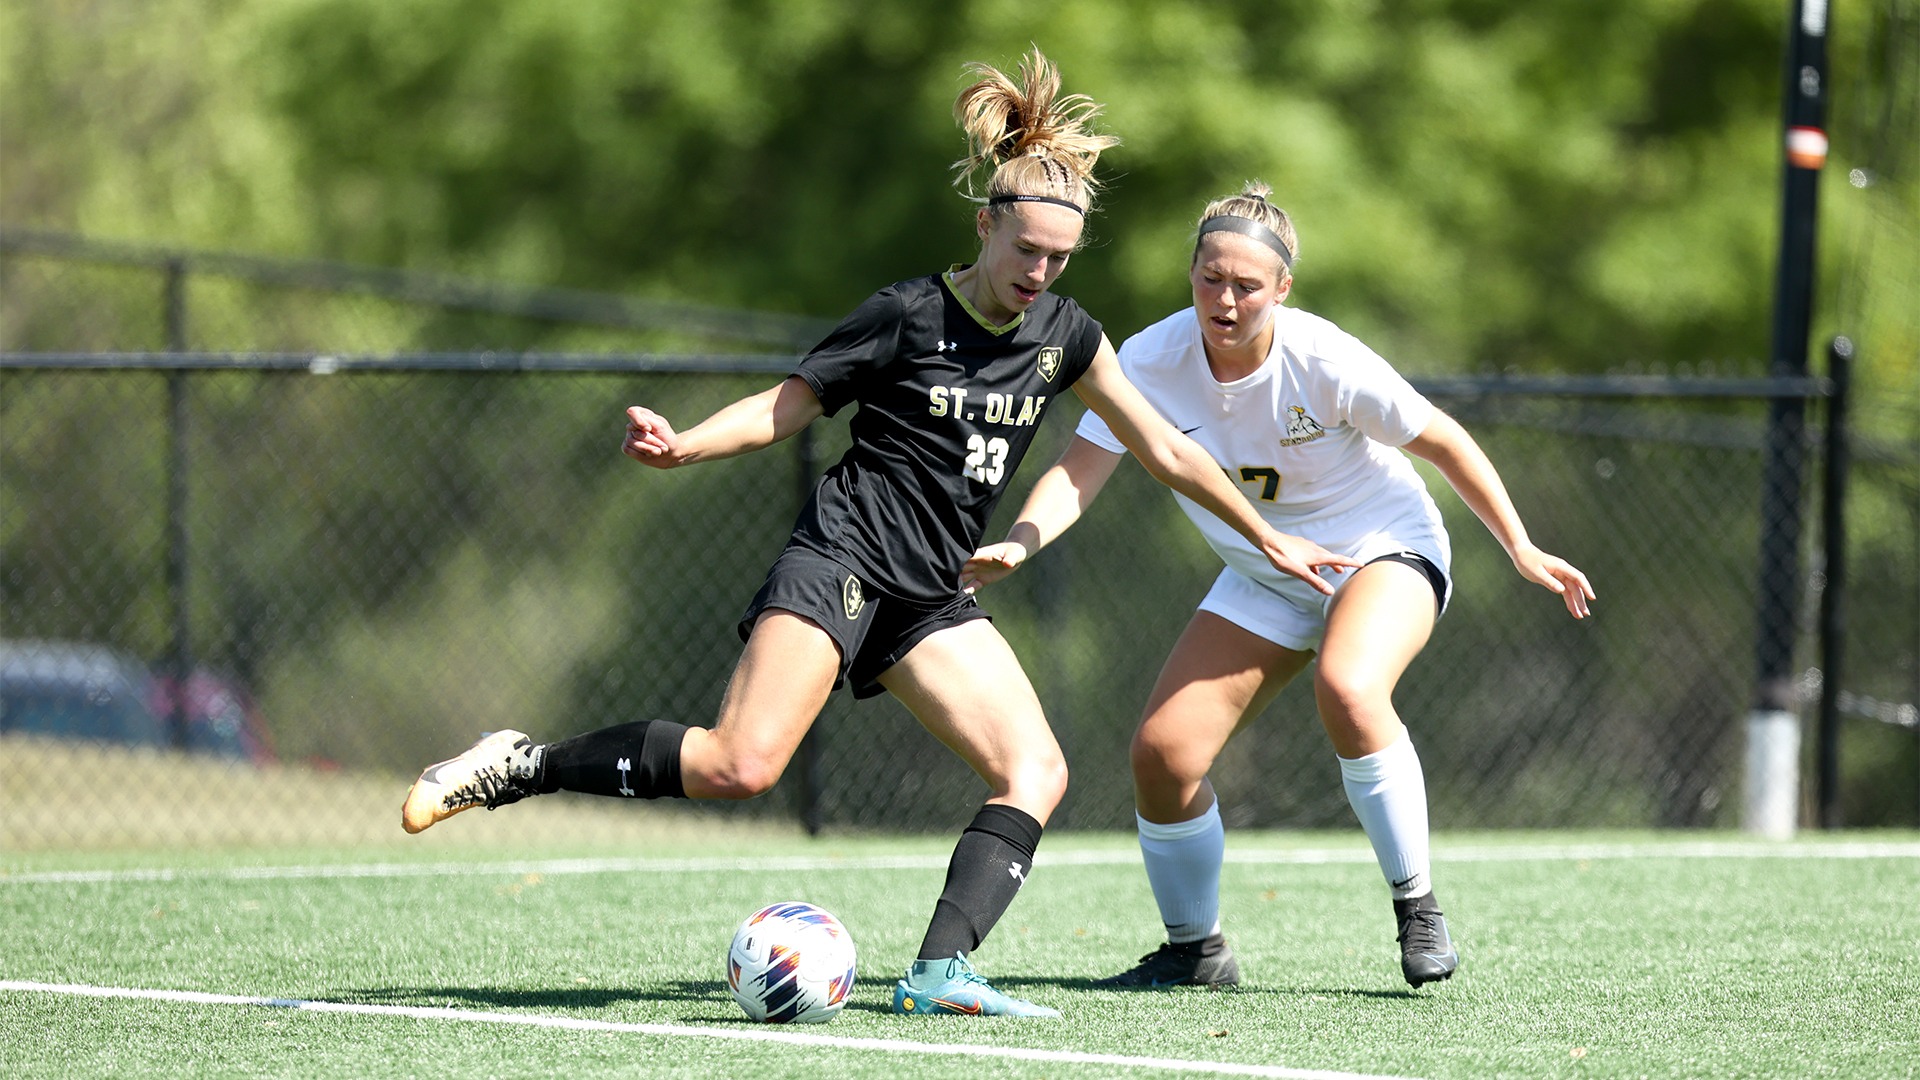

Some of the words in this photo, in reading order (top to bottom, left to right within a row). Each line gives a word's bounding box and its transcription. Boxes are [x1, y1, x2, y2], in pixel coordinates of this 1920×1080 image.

[929, 385, 975, 420] ST.
[984, 393, 1047, 426] OLAF
[962, 433, 1010, 486] 23
[1222, 465, 1282, 502] 7
